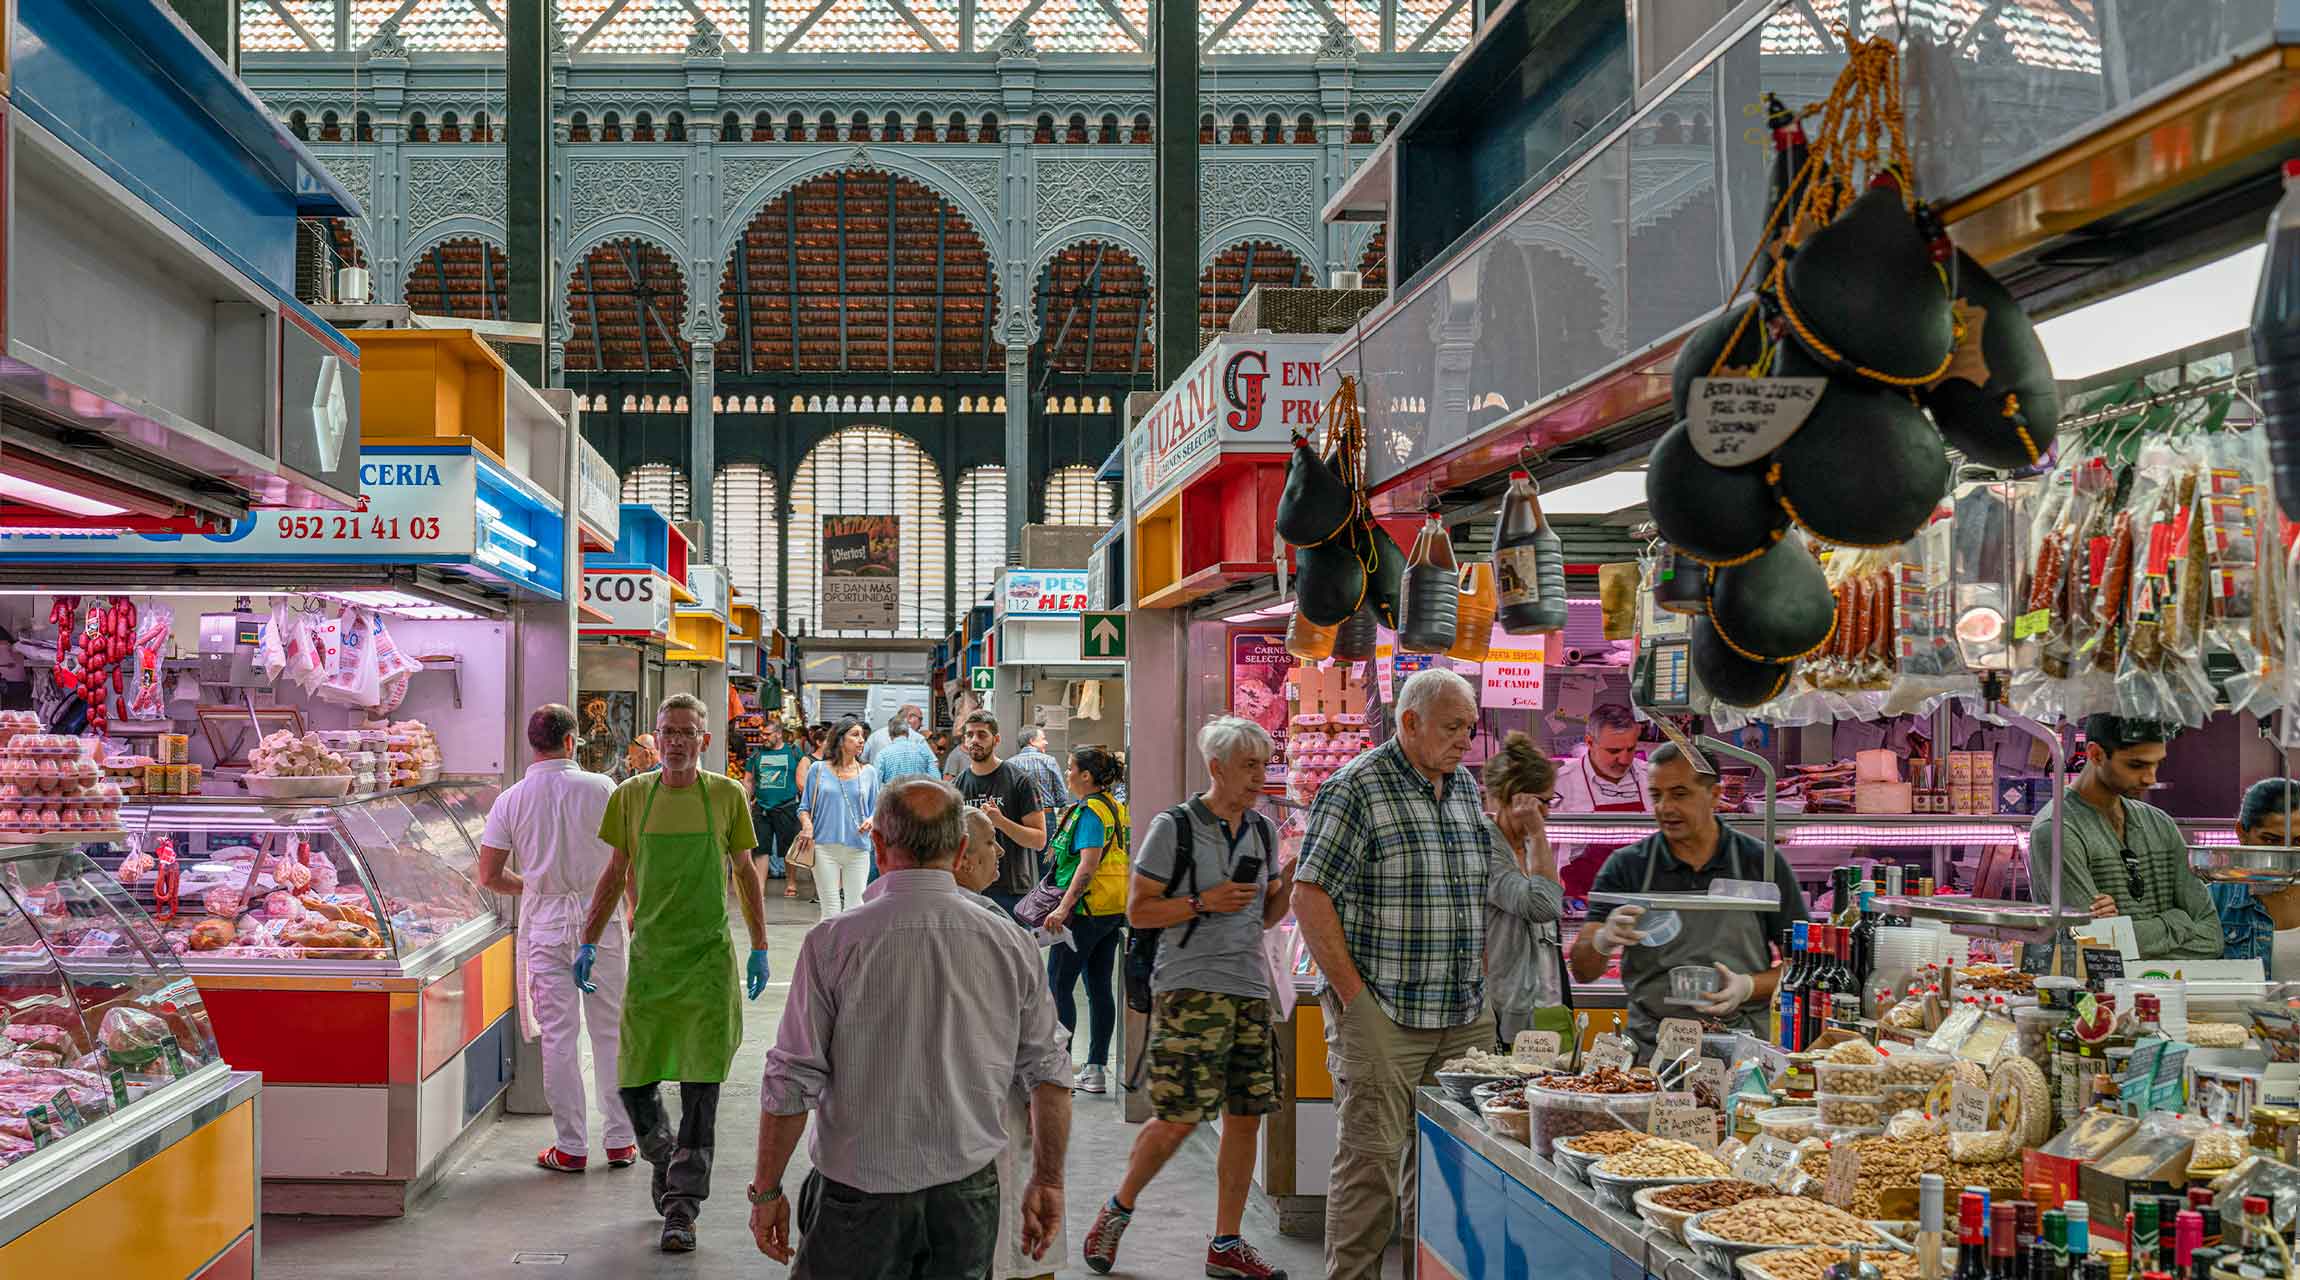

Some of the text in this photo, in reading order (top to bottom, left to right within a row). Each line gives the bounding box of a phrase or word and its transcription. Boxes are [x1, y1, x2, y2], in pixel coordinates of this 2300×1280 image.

[279, 514, 441, 539] 952 21 41 03
[843, 583, 866, 593] DAN
[1045, 577, 1086, 591] PES
[824, 593, 898, 603] OPORTUNIDAD
[1038, 593, 1088, 609] HER
[1245, 655, 1291, 664] SELECTAS
[1498, 667, 1531, 676] POLLO
[1488, 679, 1540, 689] DE CAMPO
